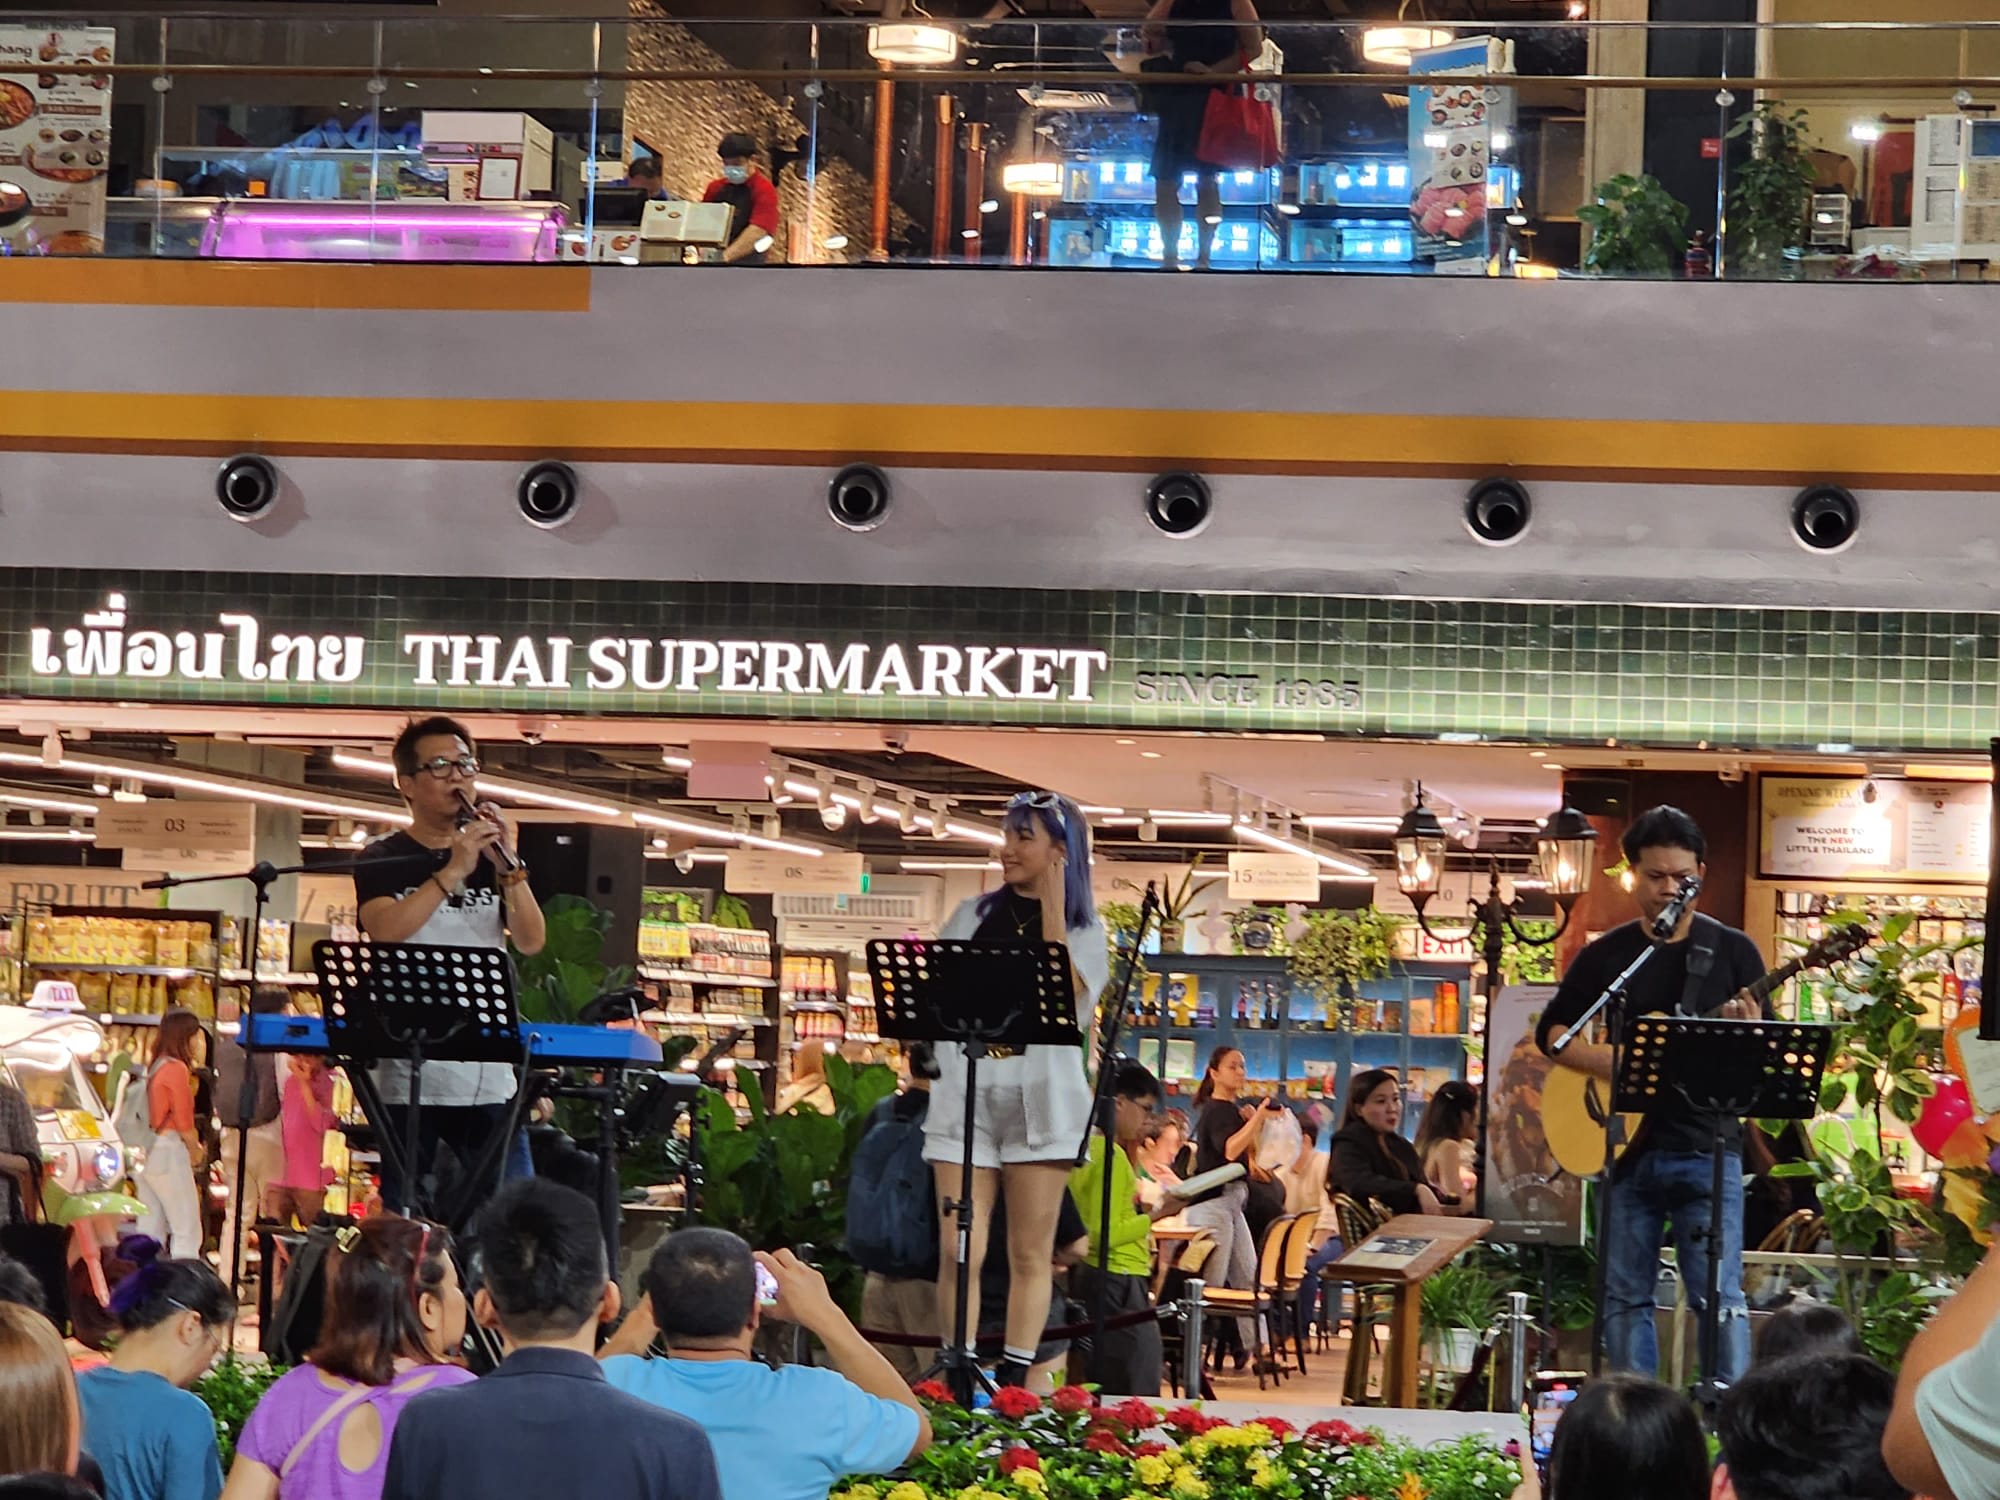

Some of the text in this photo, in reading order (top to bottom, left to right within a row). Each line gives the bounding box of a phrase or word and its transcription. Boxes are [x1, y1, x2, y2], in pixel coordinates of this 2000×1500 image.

[31, 593, 365, 681] เพื่อนไทย
[404, 634, 1107, 701] THAI SUPERMARKET
[1134, 671, 1360, 709] SINCE 1985
[164, 818, 185, 833] 03
[1796, 827, 1848, 835] WELCOME
[1807, 836, 1827, 844] THE
[1786, 845, 1874, 854] LITTLE THAILAND
[1233, 869, 1253, 883] 15
[9, 882, 139, 916] FRUIT
